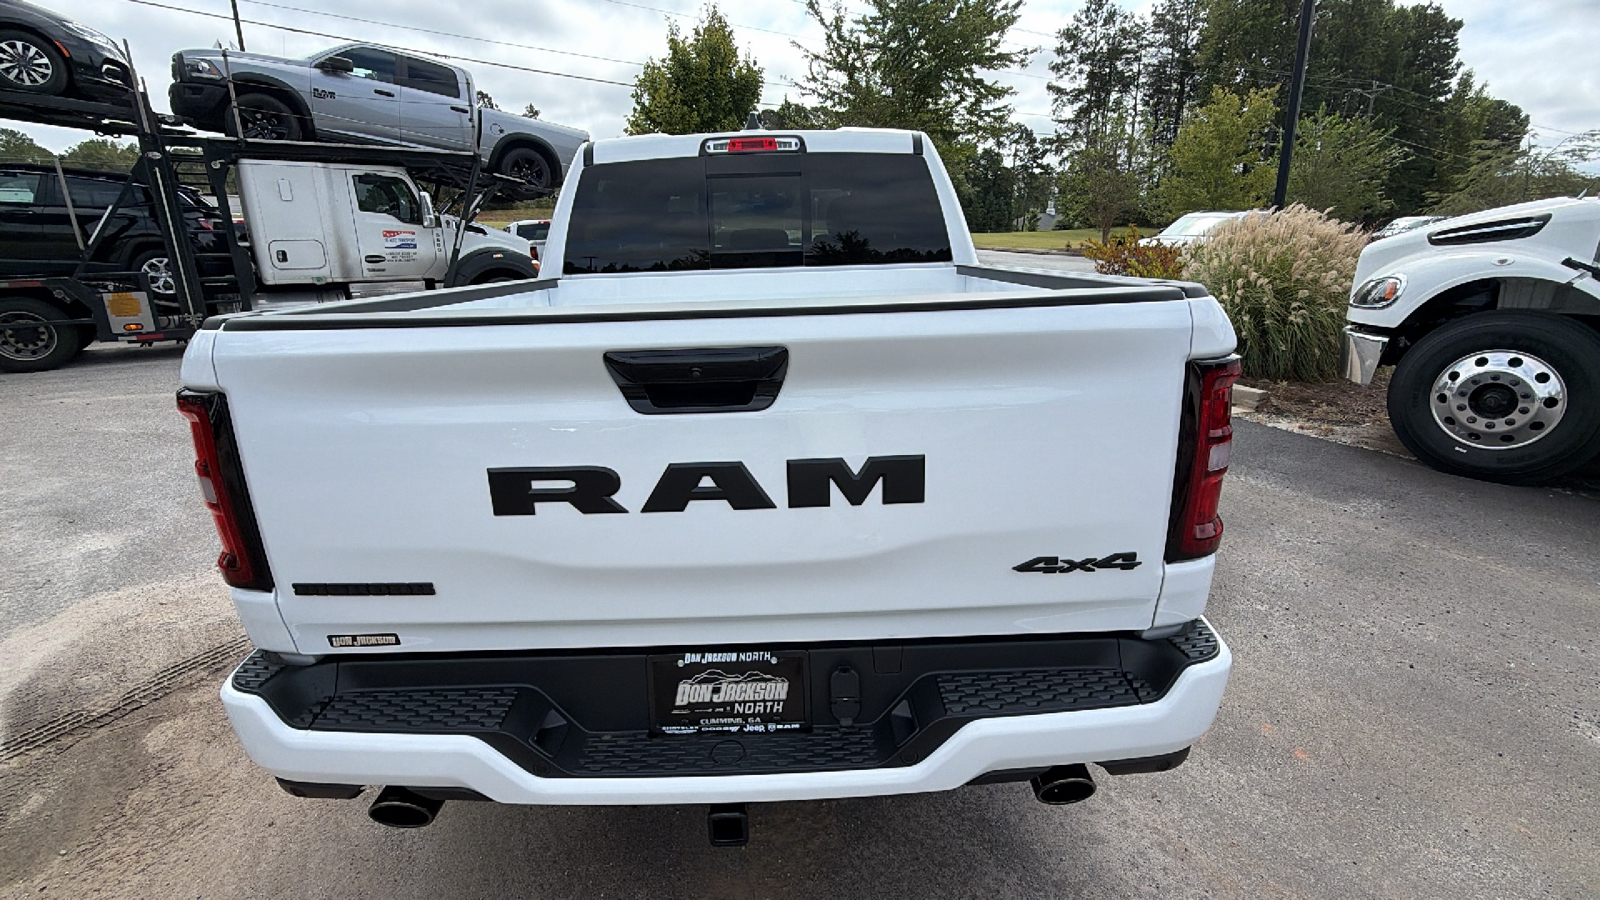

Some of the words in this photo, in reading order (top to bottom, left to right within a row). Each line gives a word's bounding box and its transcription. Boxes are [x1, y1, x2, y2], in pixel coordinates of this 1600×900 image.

[487, 454, 926, 516] RAM
[1011, 551, 1142, 574] 4x4
[332, 636, 353, 647] DON
[353, 635, 396, 646] JACKSON
[684, 653, 701, 664] DON
[739, 651, 771, 661] NORTH
[675, 682, 713, 706] DON
[712, 681, 789, 702] JACKSON
[734, 701, 784, 714] NORTH
[748, 716, 762, 724] GA
[743, 723, 766, 732] Jeep
